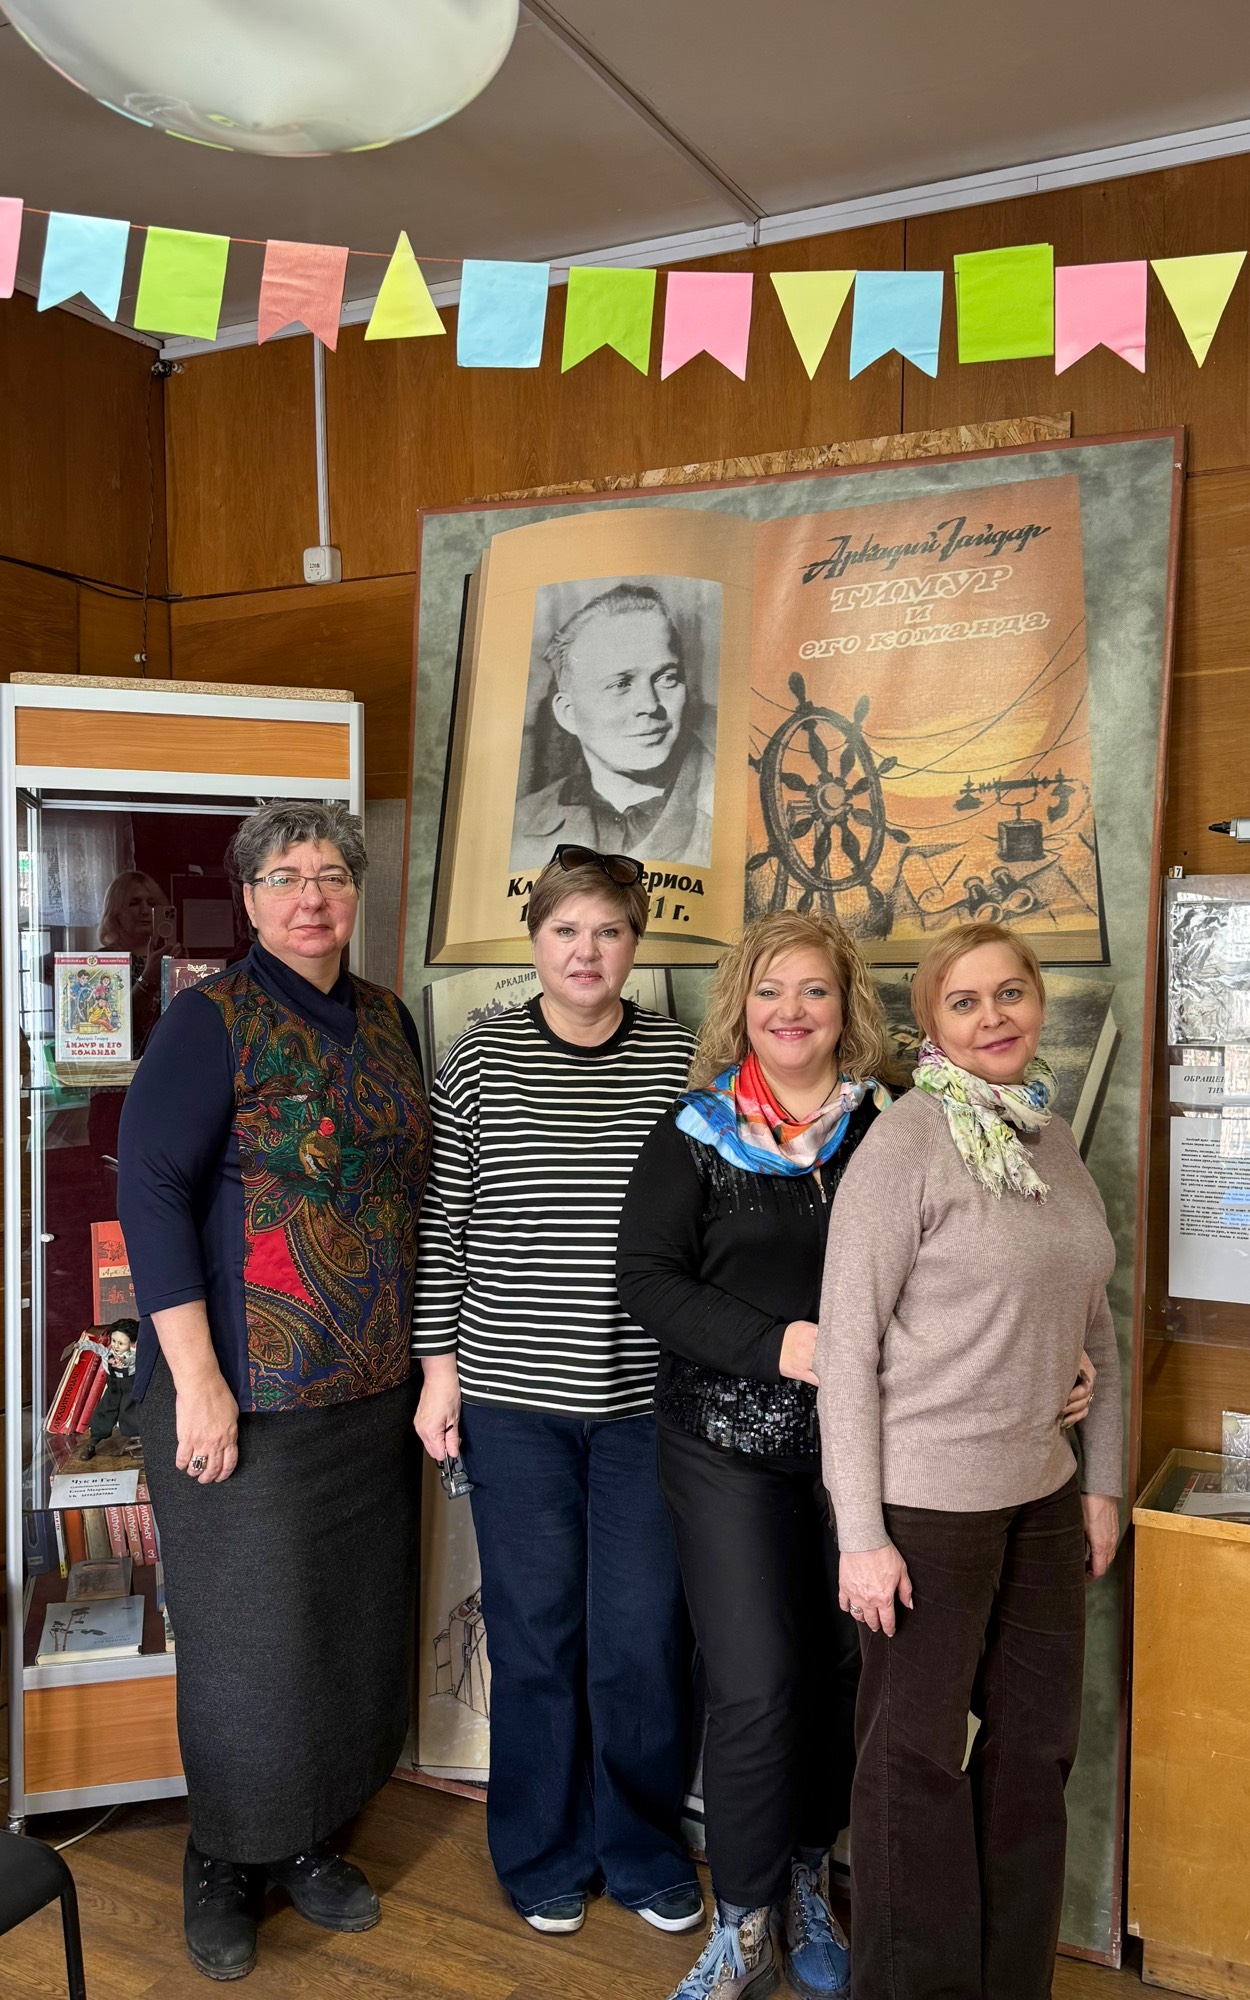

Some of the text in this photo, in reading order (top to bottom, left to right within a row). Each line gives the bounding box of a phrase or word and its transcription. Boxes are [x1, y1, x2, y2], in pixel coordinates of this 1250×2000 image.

[799, 516, 1051, 584] Аркадий Гайдар
[830, 565, 1013, 613] ТИМУР
[799, 611, 1051, 660] его команда
[642, 871, 704, 896] ериод
[134, 1551, 141, 1560] 2
[148, 1549, 155, 1559] 3
